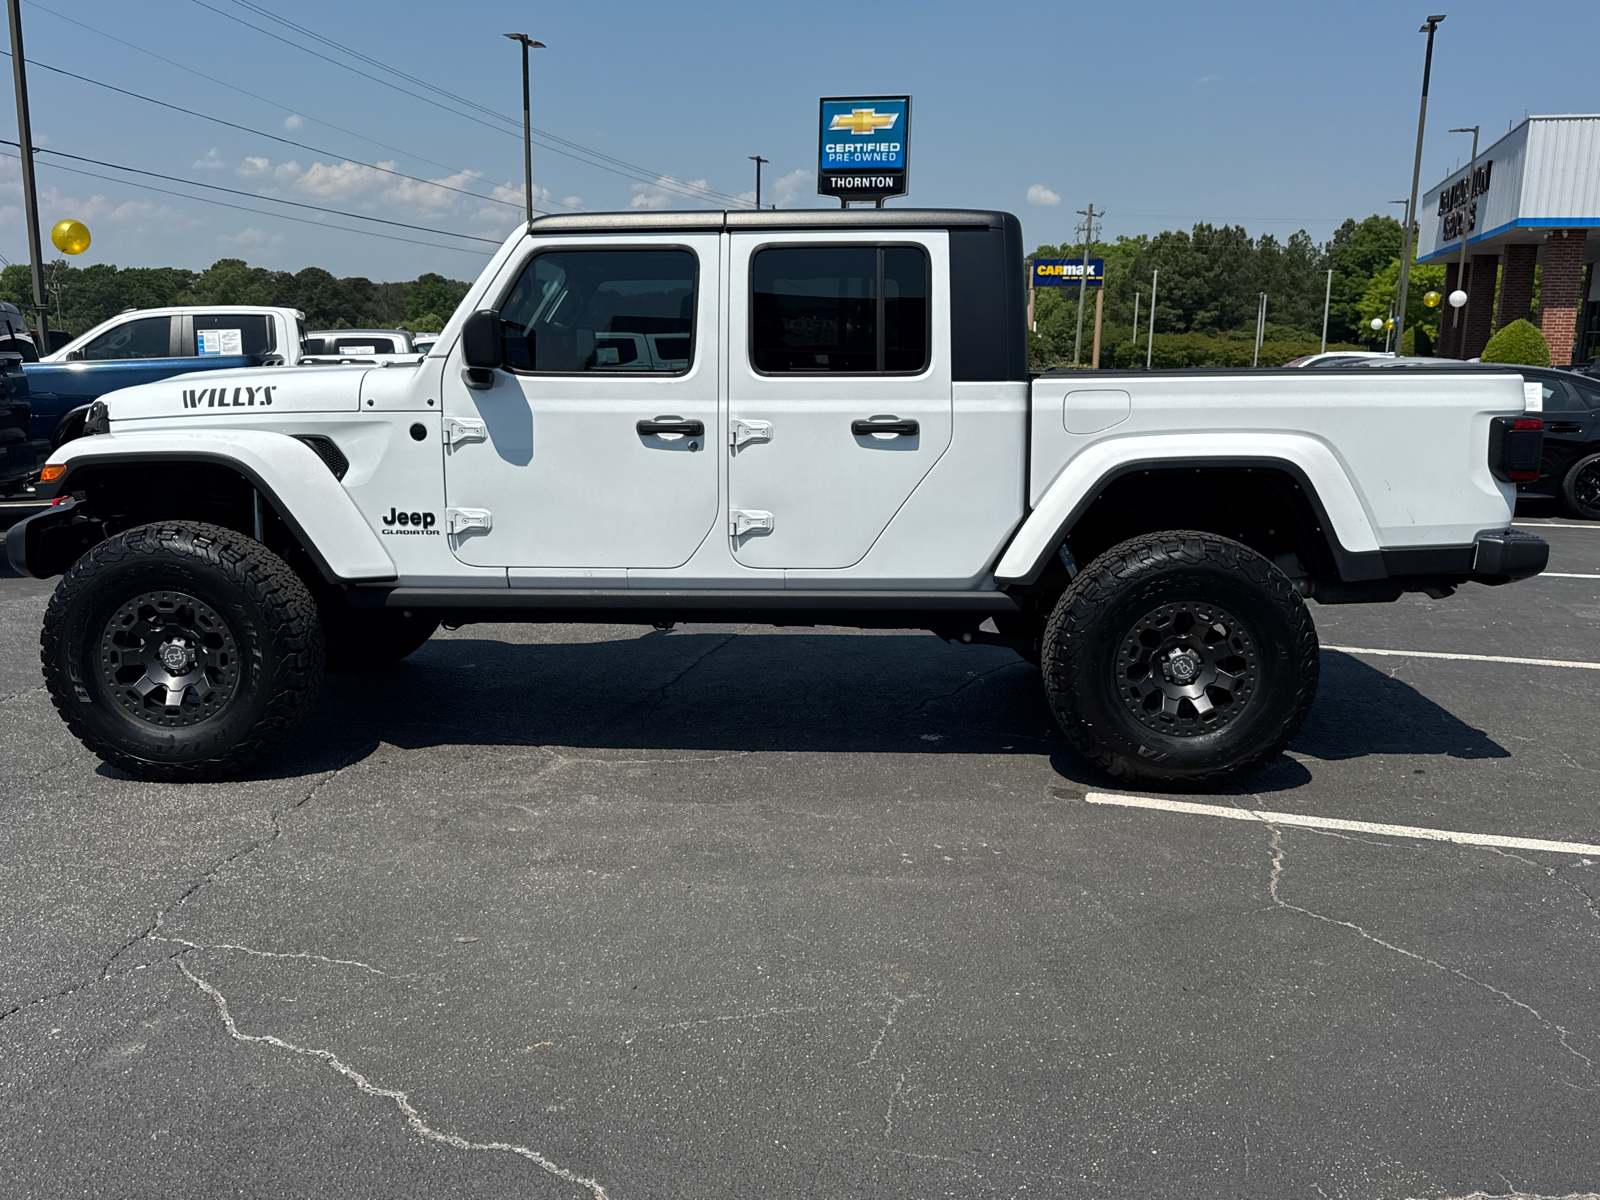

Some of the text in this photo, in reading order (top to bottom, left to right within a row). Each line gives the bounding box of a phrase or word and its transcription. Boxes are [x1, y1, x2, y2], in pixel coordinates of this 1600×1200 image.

[825, 142, 901, 153] CERTIFIED
[828, 153, 897, 162] PRE-OWNED
[830, 176, 894, 188] THORNTON
[182, 385, 278, 409] WILLYS
[382, 507, 436, 530] Jeep
[381, 528, 441, 536] GLADIATOR
